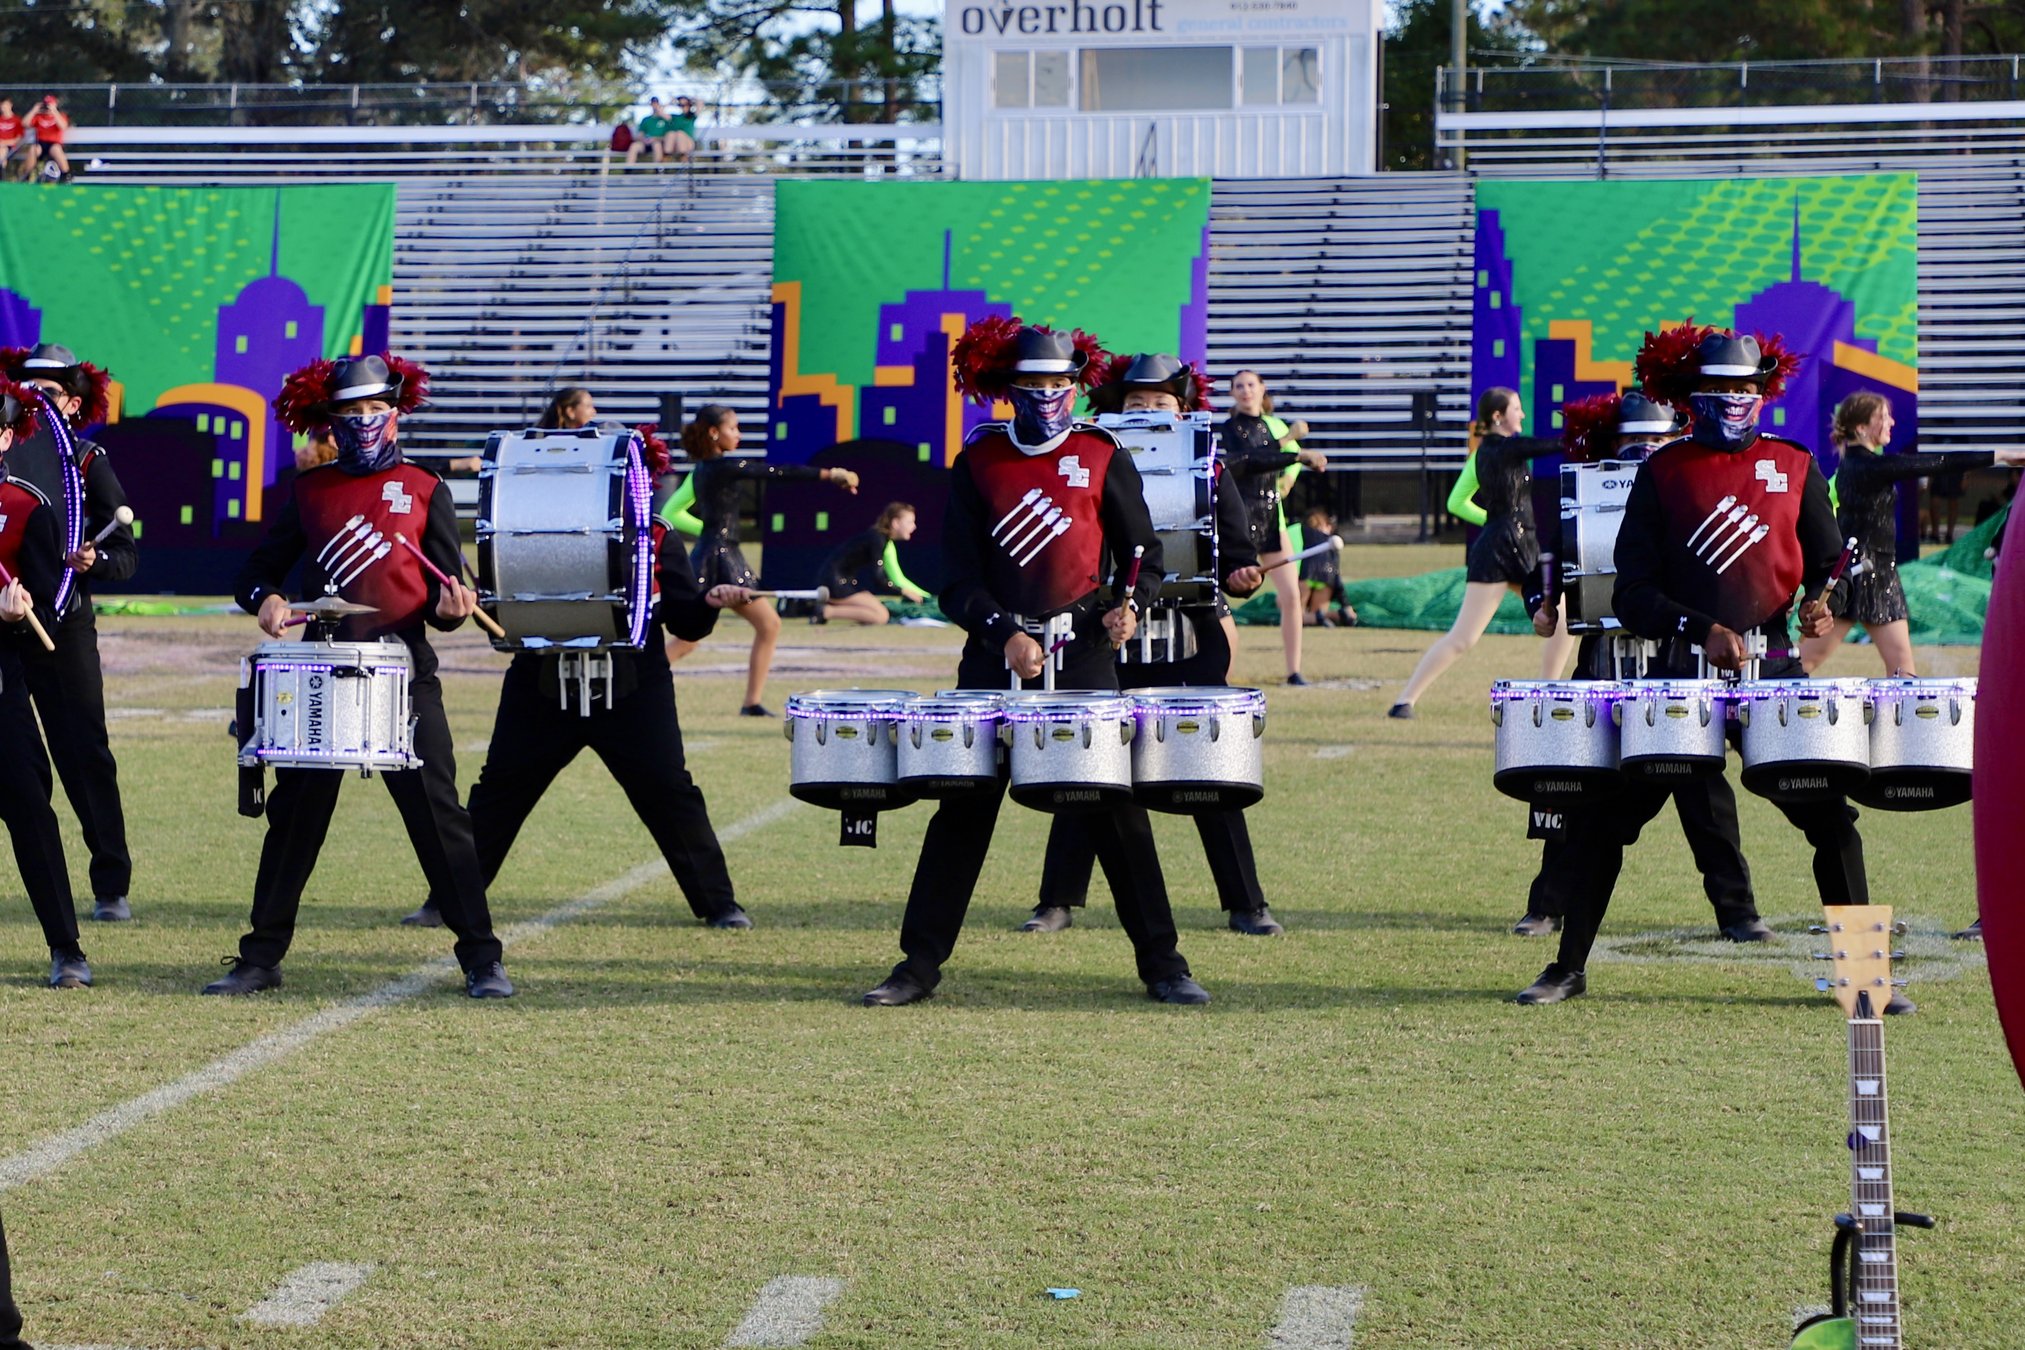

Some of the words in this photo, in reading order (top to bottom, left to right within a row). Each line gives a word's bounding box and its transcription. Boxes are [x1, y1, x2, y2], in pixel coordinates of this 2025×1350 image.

[961, 0, 1165, 35] overholt
[1176, 16, 1243, 33] general
[1248, 15, 1348, 31] contractors
[309, 691, 323, 746] YAMAHA
[1654, 762, 1692, 774] YAMAHA
[1545, 781, 1582, 792] YAMAHA
[1790, 777, 1828, 789] YAMAHA
[851, 788, 887, 800] YAMAHA
[1065, 790, 1101, 801] YAMAHA
[1184, 791, 1220, 802] YAMAHA
[1897, 786, 1934, 798] YAMAHA
